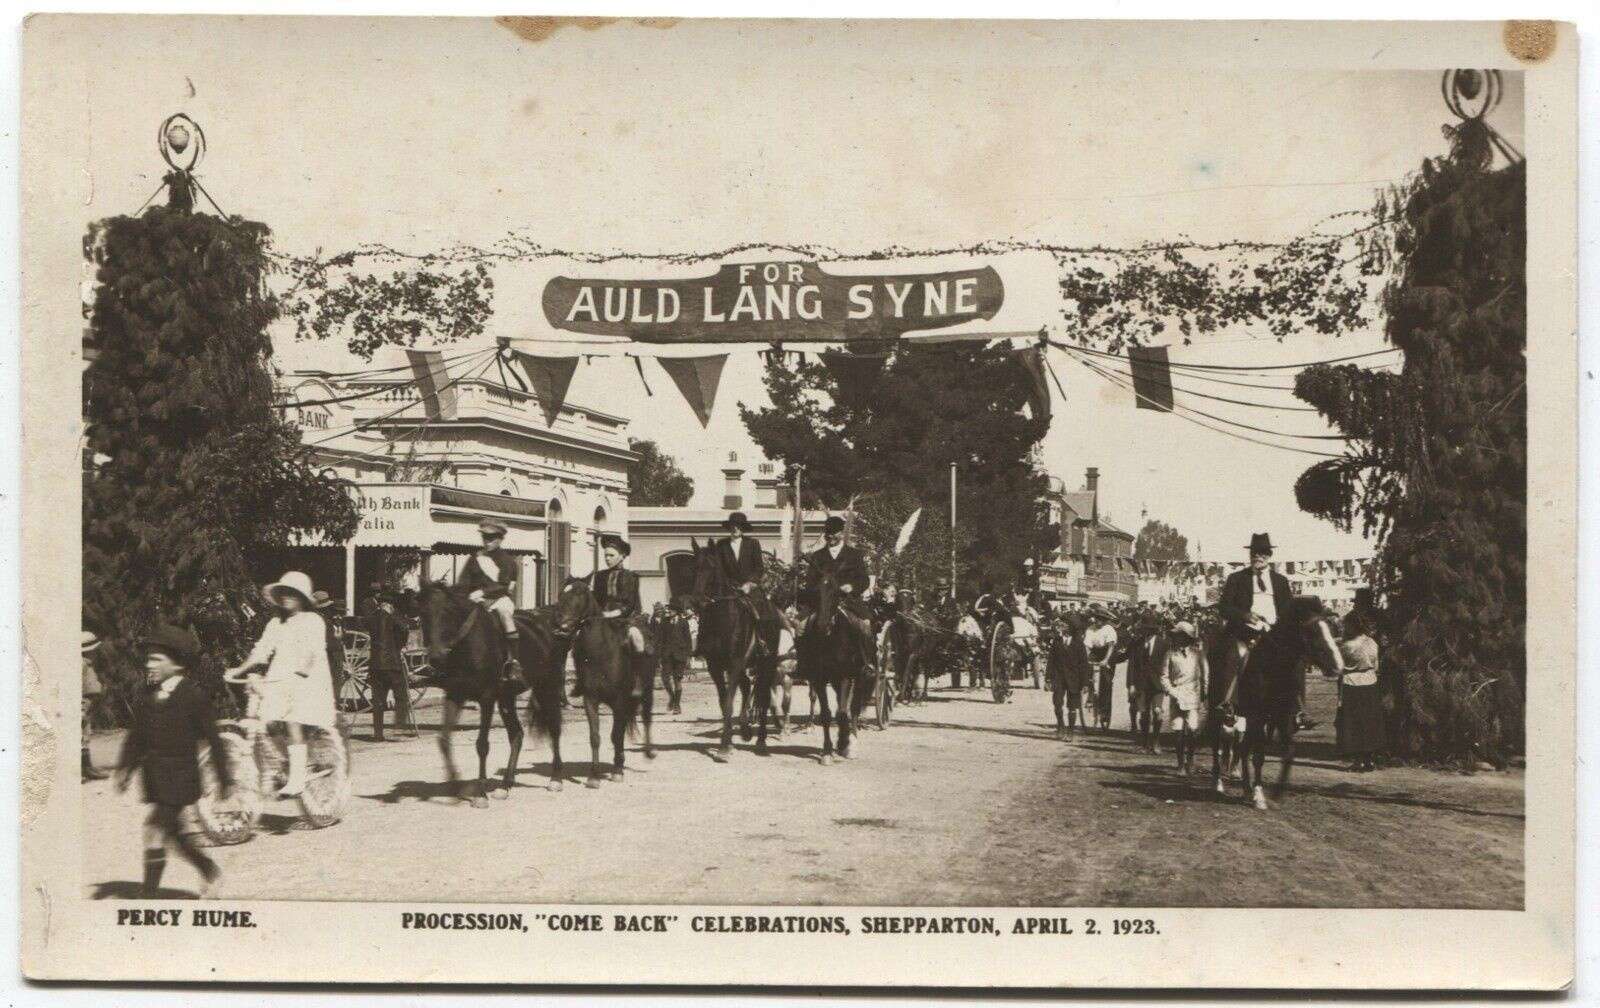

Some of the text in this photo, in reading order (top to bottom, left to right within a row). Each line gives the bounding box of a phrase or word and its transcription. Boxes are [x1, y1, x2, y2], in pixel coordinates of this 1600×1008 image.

[739, 263, 804, 284] FOR
[565, 277, 979, 325] AULD LANG SYNE
[298, 408, 329, 430] BANK
[381, 496, 421, 511] Bank
[362, 517, 396, 530] alia
